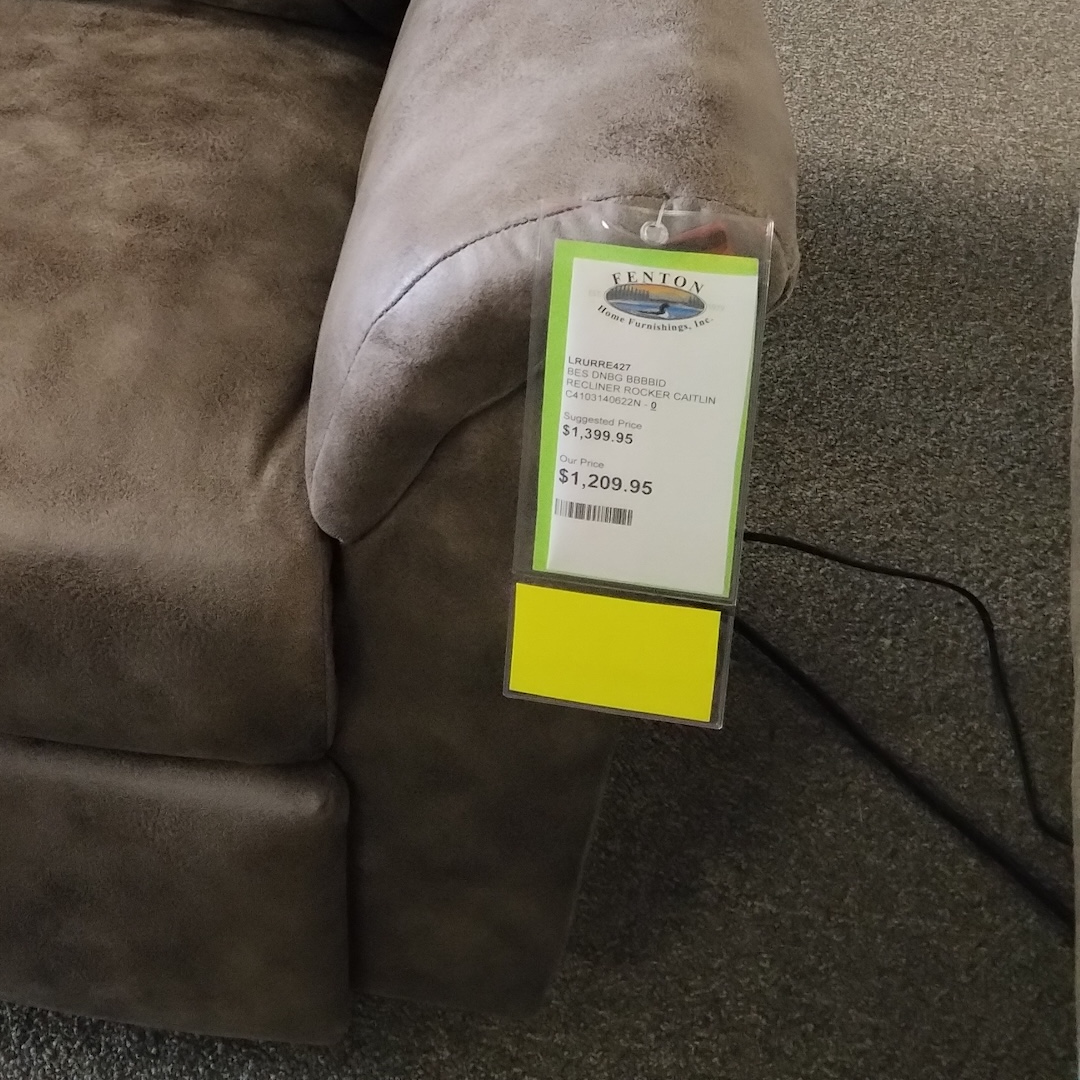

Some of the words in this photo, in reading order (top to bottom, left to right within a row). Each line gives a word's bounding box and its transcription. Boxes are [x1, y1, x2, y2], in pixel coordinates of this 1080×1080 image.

[612, 271, 704, 295] FENTON
[597, 305, 625, 324] Home
[628, 320, 692, 333] Furnishings,
[694, 316, 714, 329] Inc.
[568, 356, 631, 371] LRURRE427
[567, 367, 589, 378] BES
[592, 370, 623, 382] DNBG
[566, 378, 621, 393] RECLINER
[623, 386, 671, 399] ROCKER
[673, 392, 716, 405] CAITLIN
[563, 412, 615, 426] Suggested
[617, 419, 643, 430] Price
[562, 424, 633, 445] $1,399.95
[559, 454, 577, 465] Our
[580, 458, 605, 469] Price
[558, 468, 653, 495] $1,209.95
